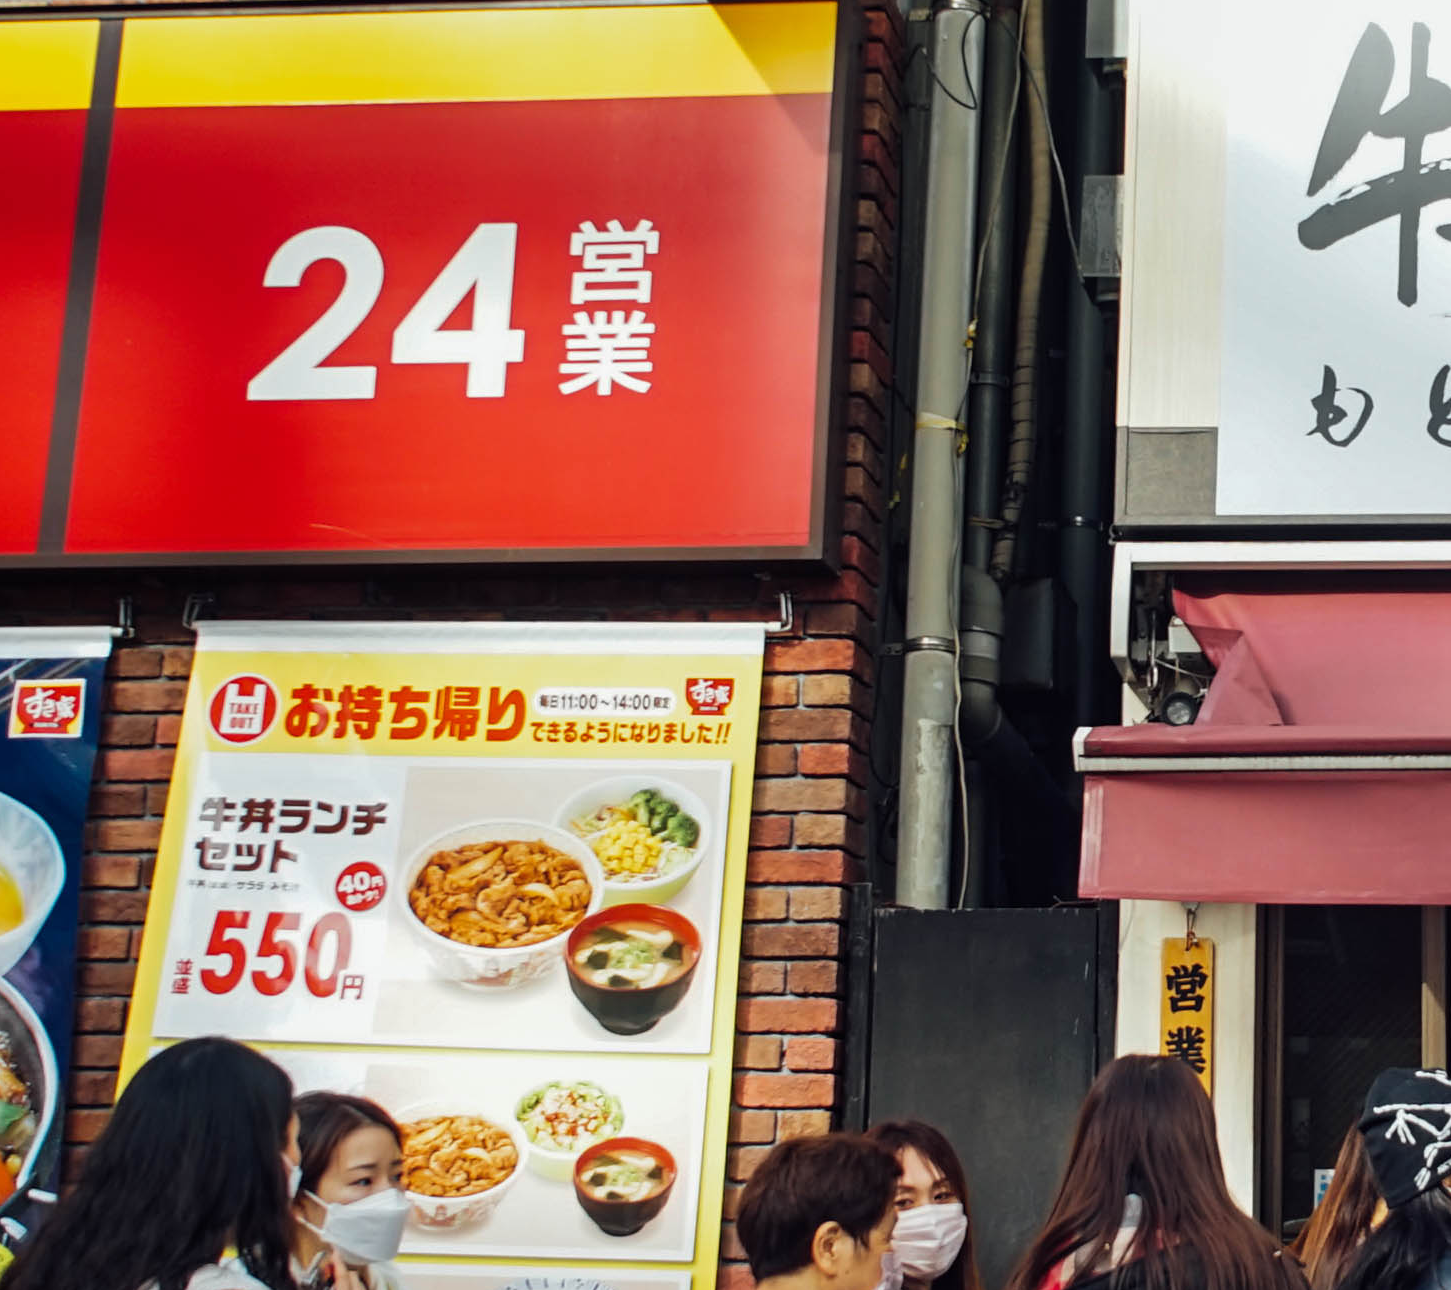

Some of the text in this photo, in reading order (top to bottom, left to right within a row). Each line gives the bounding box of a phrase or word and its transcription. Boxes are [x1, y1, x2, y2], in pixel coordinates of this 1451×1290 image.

[246, 222, 525, 402] 24
[558, 219, 660, 396] 営業
[229, 703, 262, 715] TAKE
[230, 716, 254, 728] OUT
[283, 682, 529, 743] お持ち帰り
[199, 796, 388, 836] 牛丼ランチ
[194, 836, 298, 873] セット
[337, 871, 384, 894] 40円
[200, 909, 365, 1001] 550円
[1165, 963, 1209, 1075] 営業
